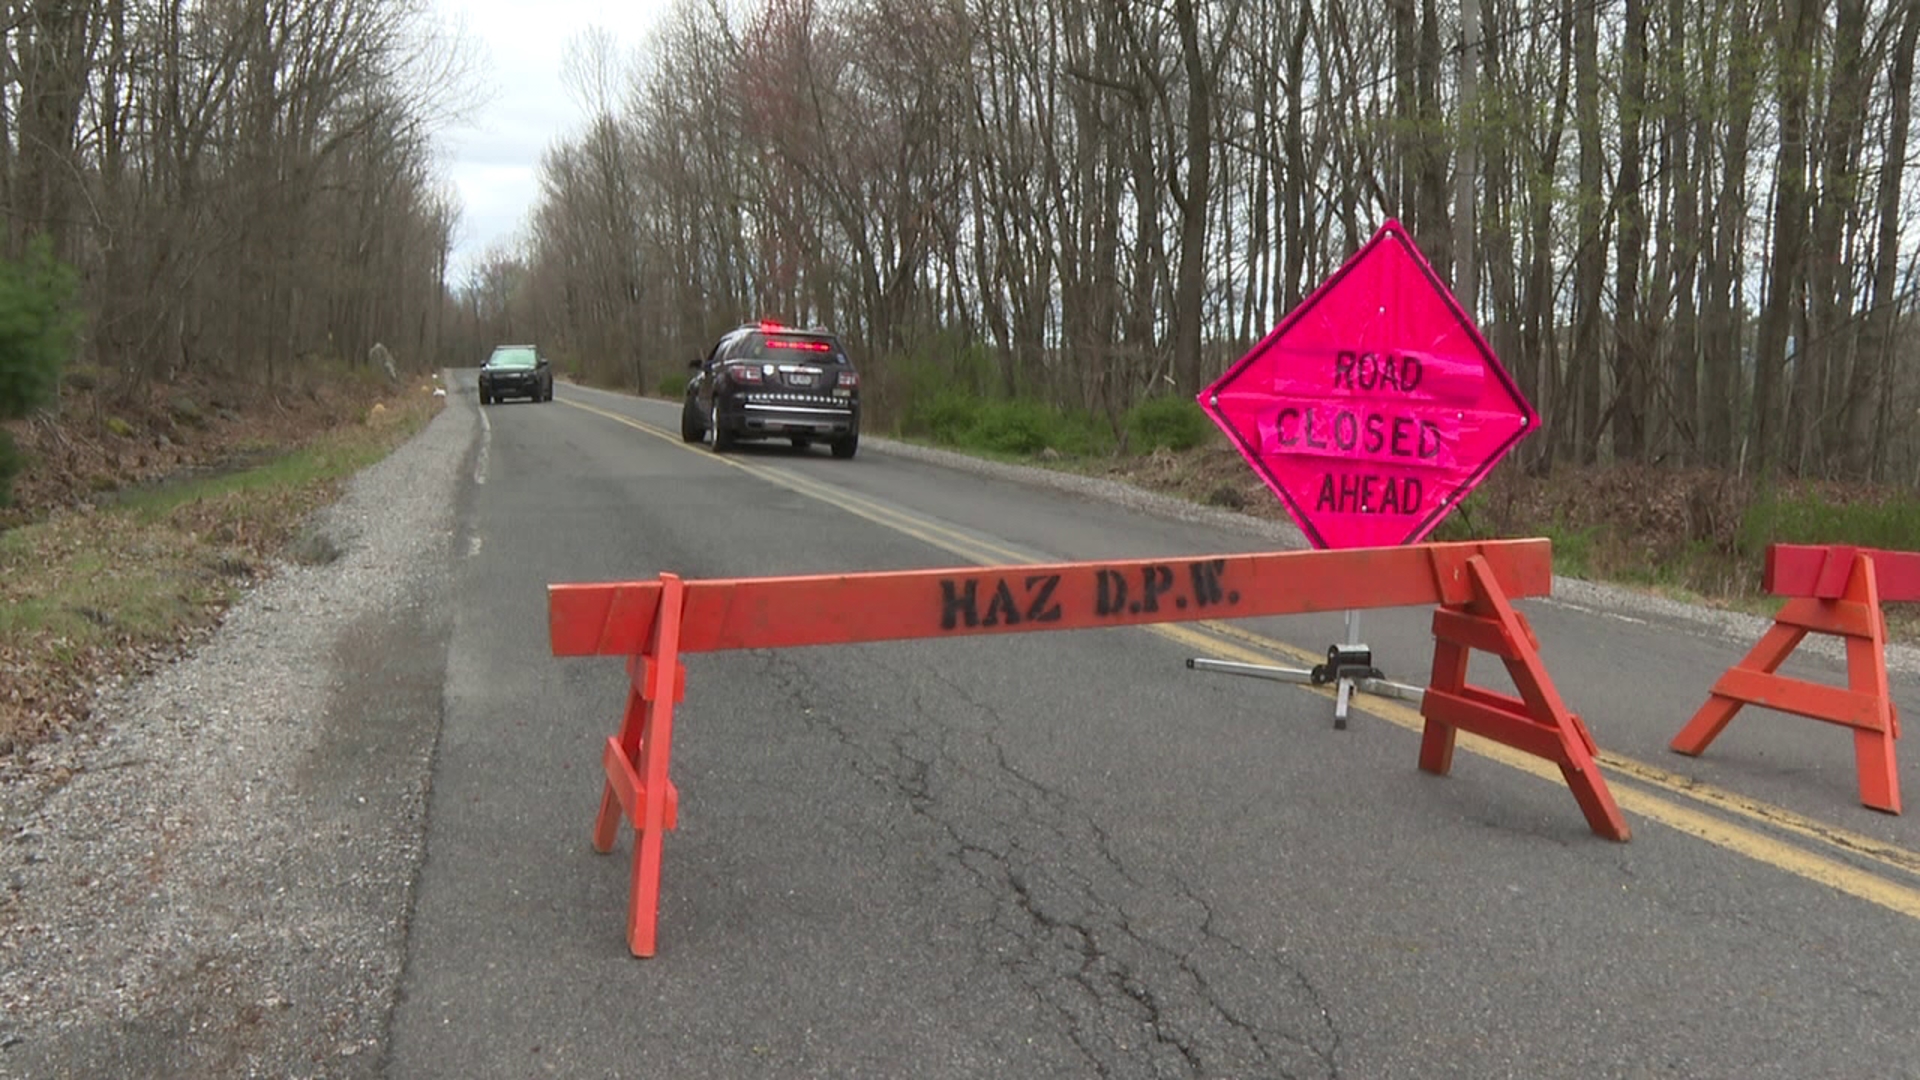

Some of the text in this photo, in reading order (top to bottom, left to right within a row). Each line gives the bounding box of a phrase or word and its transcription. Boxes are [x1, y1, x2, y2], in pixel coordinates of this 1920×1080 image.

[1334, 351, 1424, 392] ROAD
[1275, 407, 1442, 460] CLOSED
[1315, 473, 1423, 515] AHEAD
[940, 559, 1240, 630] HAZ D.P.W.
